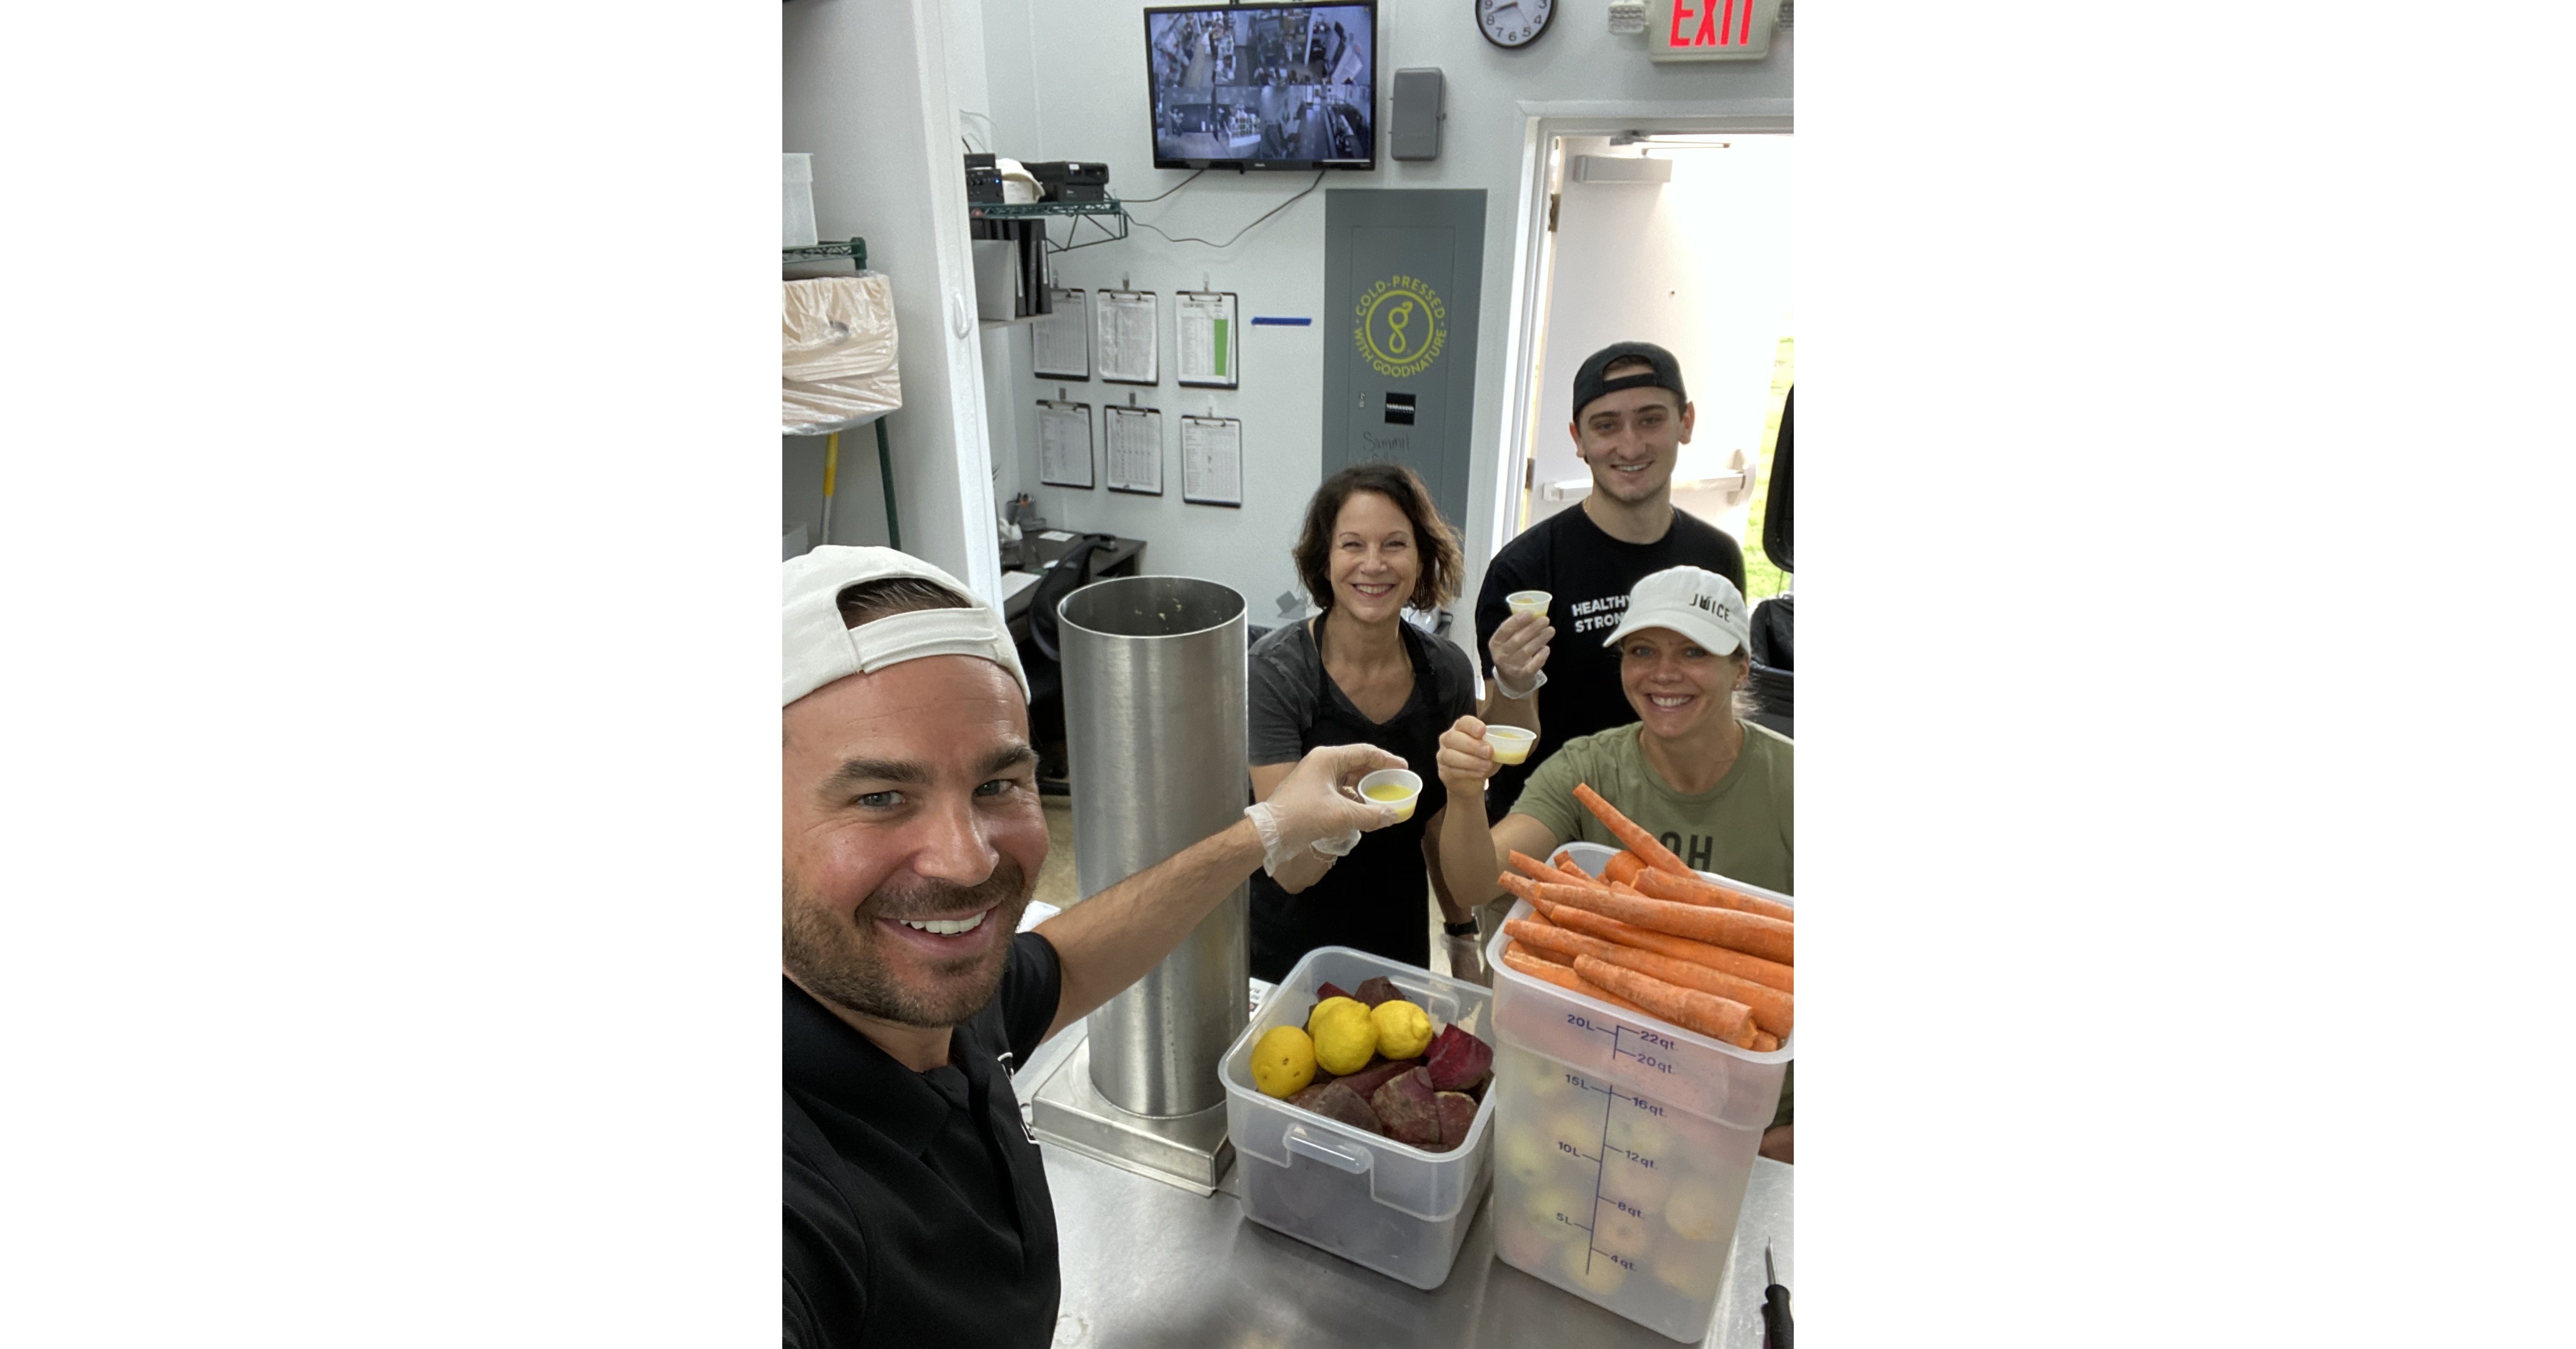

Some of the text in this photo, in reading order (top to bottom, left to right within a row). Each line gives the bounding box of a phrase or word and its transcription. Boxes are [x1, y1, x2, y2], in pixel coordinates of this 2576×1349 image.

[1484, 0, 1493, 9] 9
[1539, 0, 1547, 9] 3
[1487, 13, 1495, 25] 8
[1534, 14, 1542, 24] 4
[1669, 0, 1754, 47] EXIT
[1496, 26, 1504, 37] 7
[1509, 31, 1517, 41] 6
[1523, 26, 1531, 37] 5
[1354, 328, 1447, 377] WITH GOODNATURE
[1689, 594, 1730, 623] JUICE
[1575, 612, 1624, 633] STRON
[1567, 1014, 1594, 1031] 20L
[1565, 1074, 1588, 1090] 15L
[1558, 1141, 1580, 1157] 10L
